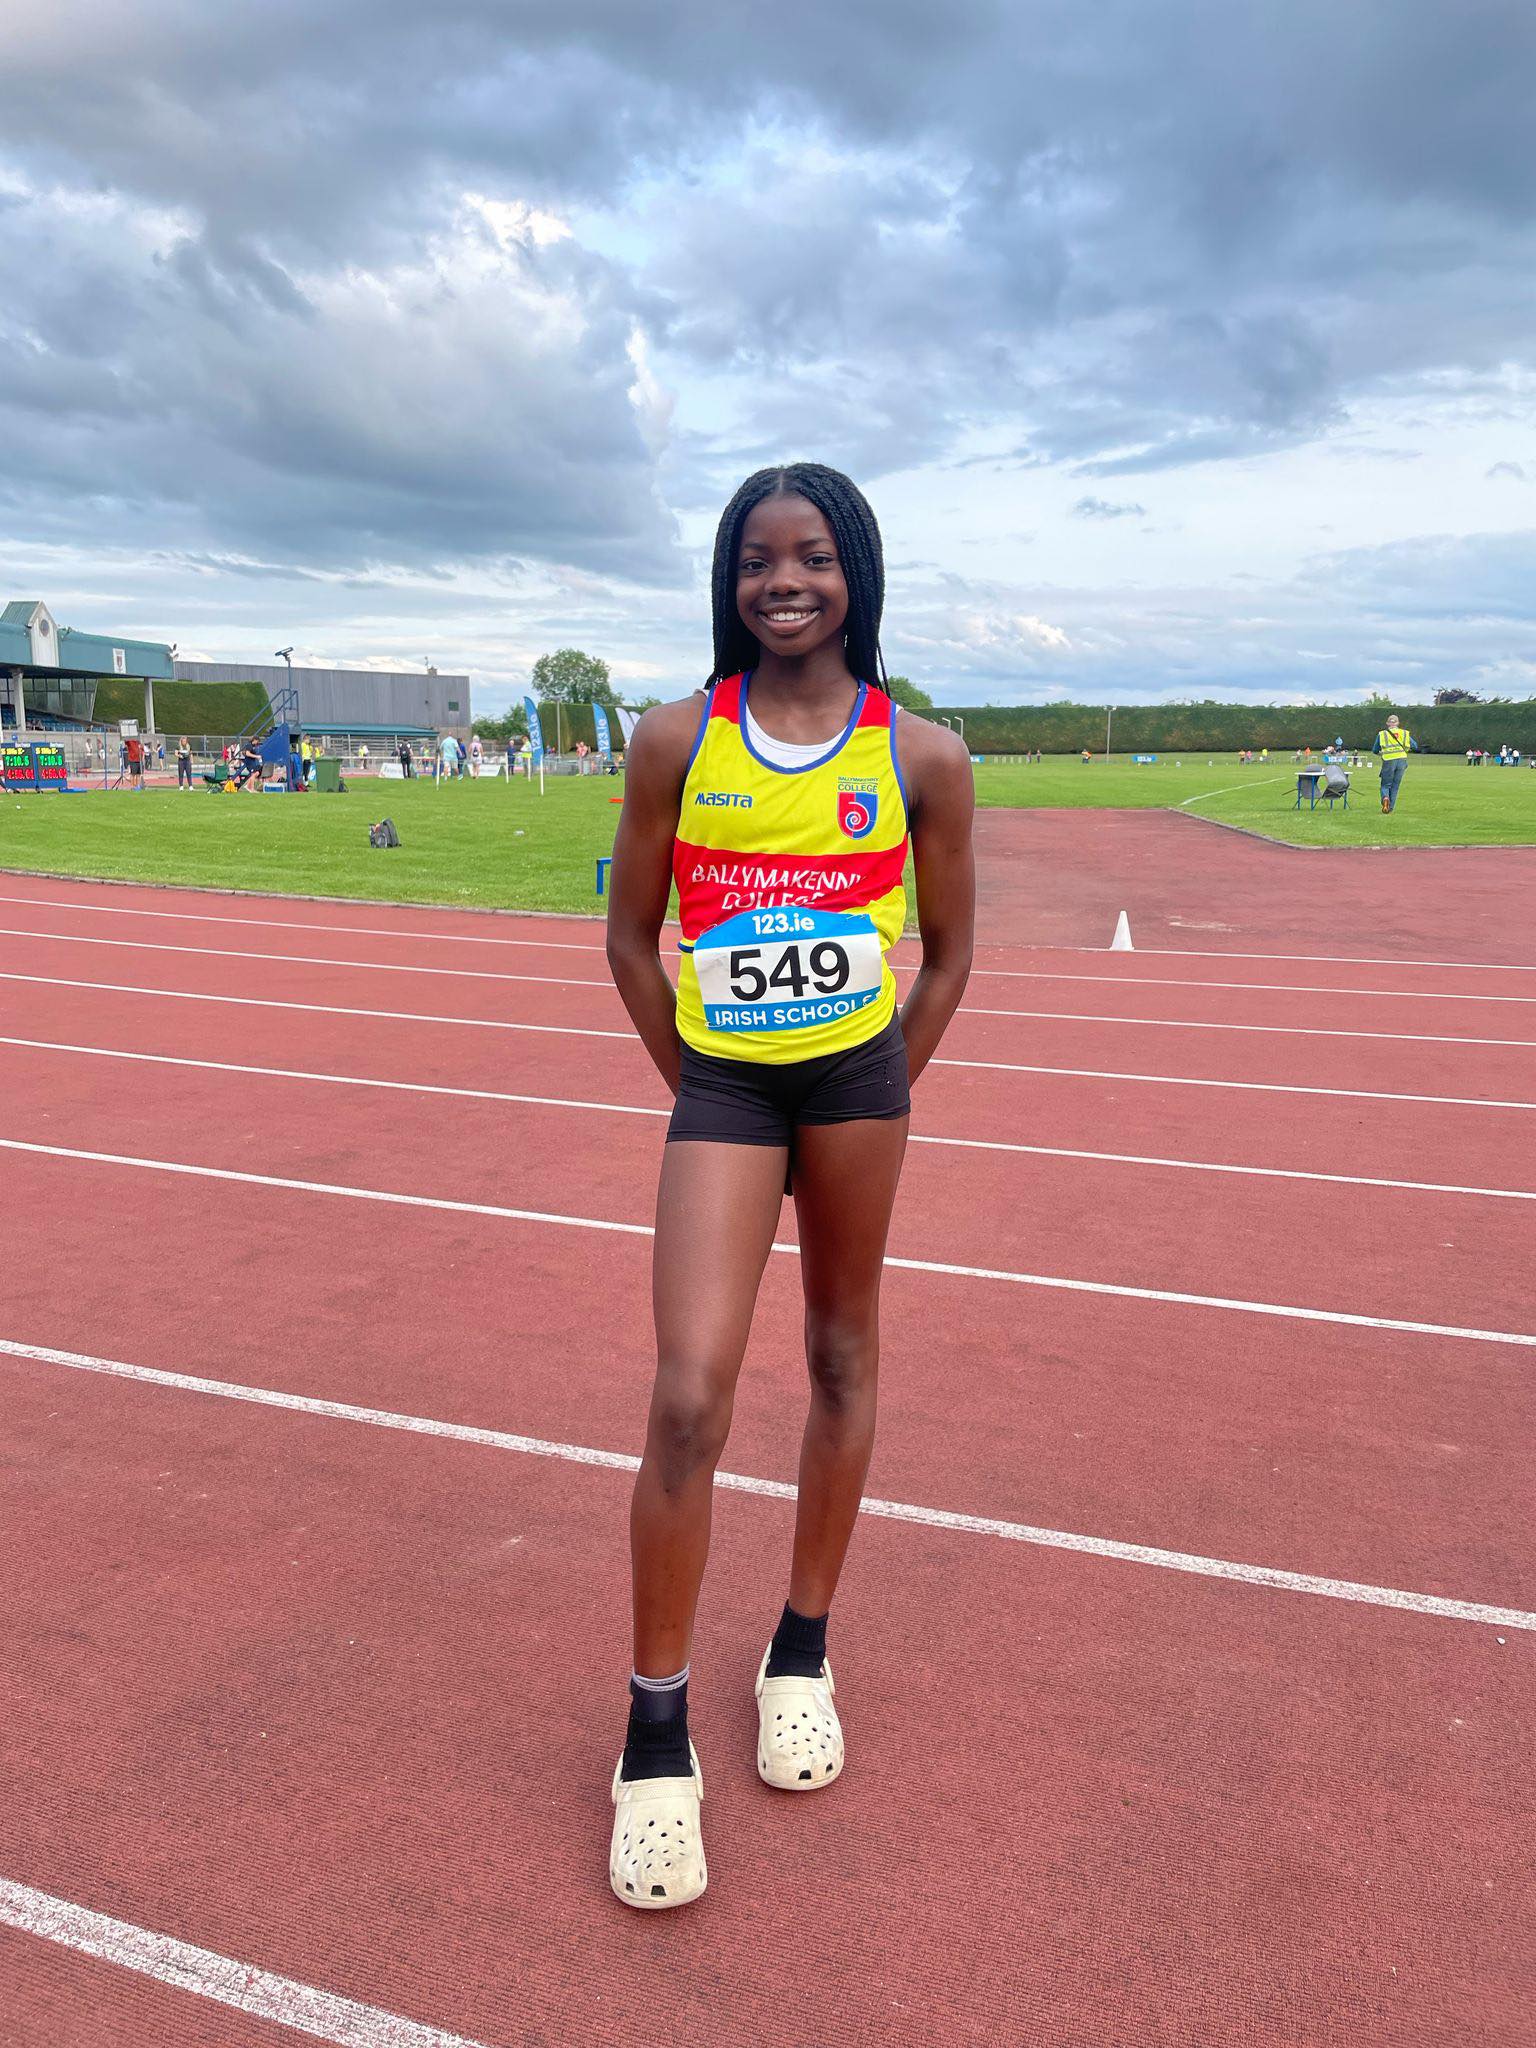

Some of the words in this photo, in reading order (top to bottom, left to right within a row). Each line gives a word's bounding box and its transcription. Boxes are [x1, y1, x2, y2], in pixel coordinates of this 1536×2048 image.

[837, 784, 878, 793] COLLEGE
[752, 913, 815, 935] 123.ie
[730, 941, 850, 1002] 549
[715, 1010, 767, 1026] IRISH
